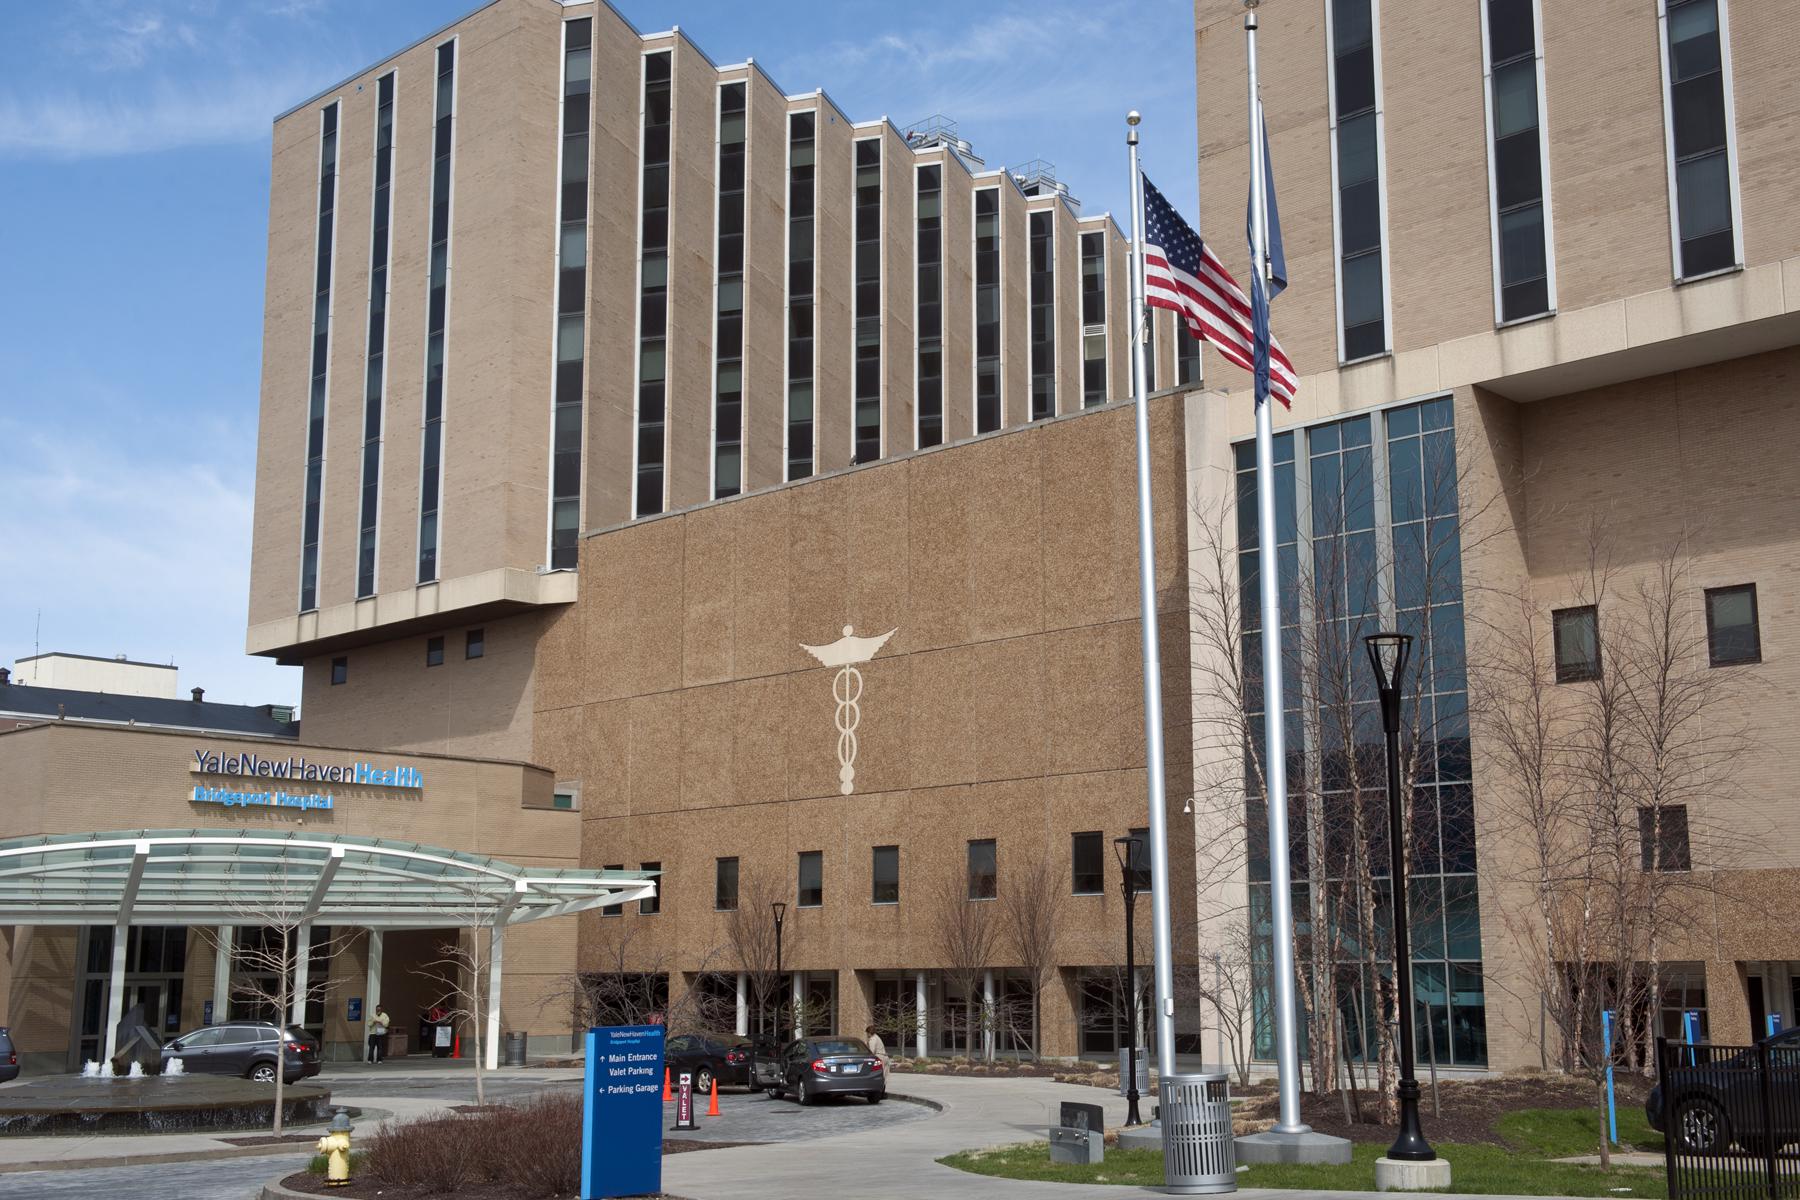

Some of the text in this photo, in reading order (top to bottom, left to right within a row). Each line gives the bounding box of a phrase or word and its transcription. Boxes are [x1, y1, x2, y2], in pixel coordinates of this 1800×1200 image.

[195, 750, 422, 787] YaleNewHavenHealth
[194, 786, 333, 810] Bridgeport Hospital
[609, 1053, 657, 1062] Main Entrance
[610, 1067, 654, 1076] Valet Parking
[608, 1084, 659, 1094] Parking Garage
